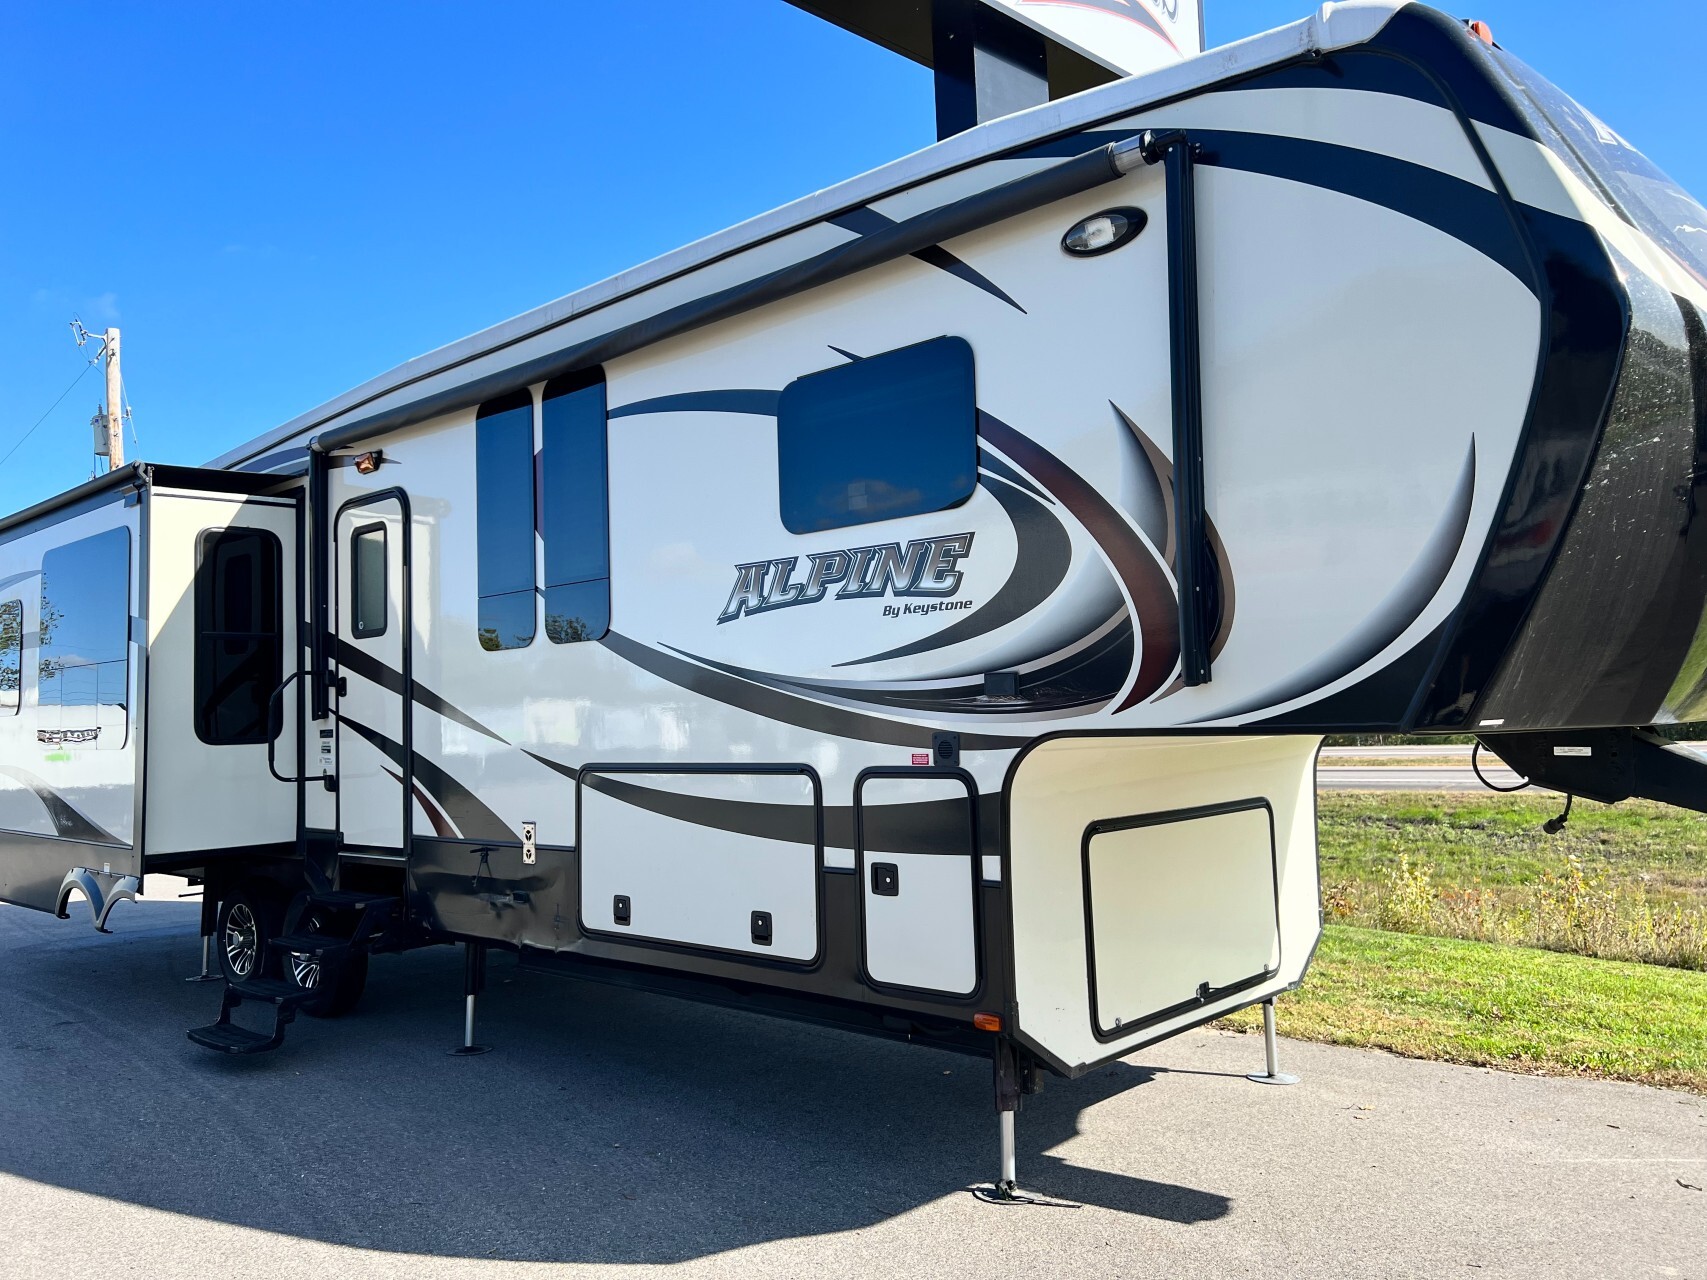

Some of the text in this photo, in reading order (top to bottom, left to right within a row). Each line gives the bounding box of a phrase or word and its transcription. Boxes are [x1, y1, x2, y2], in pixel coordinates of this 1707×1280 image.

[717, 532, 975, 625] ALPINE
[882, 600, 973, 618] By Keystone
